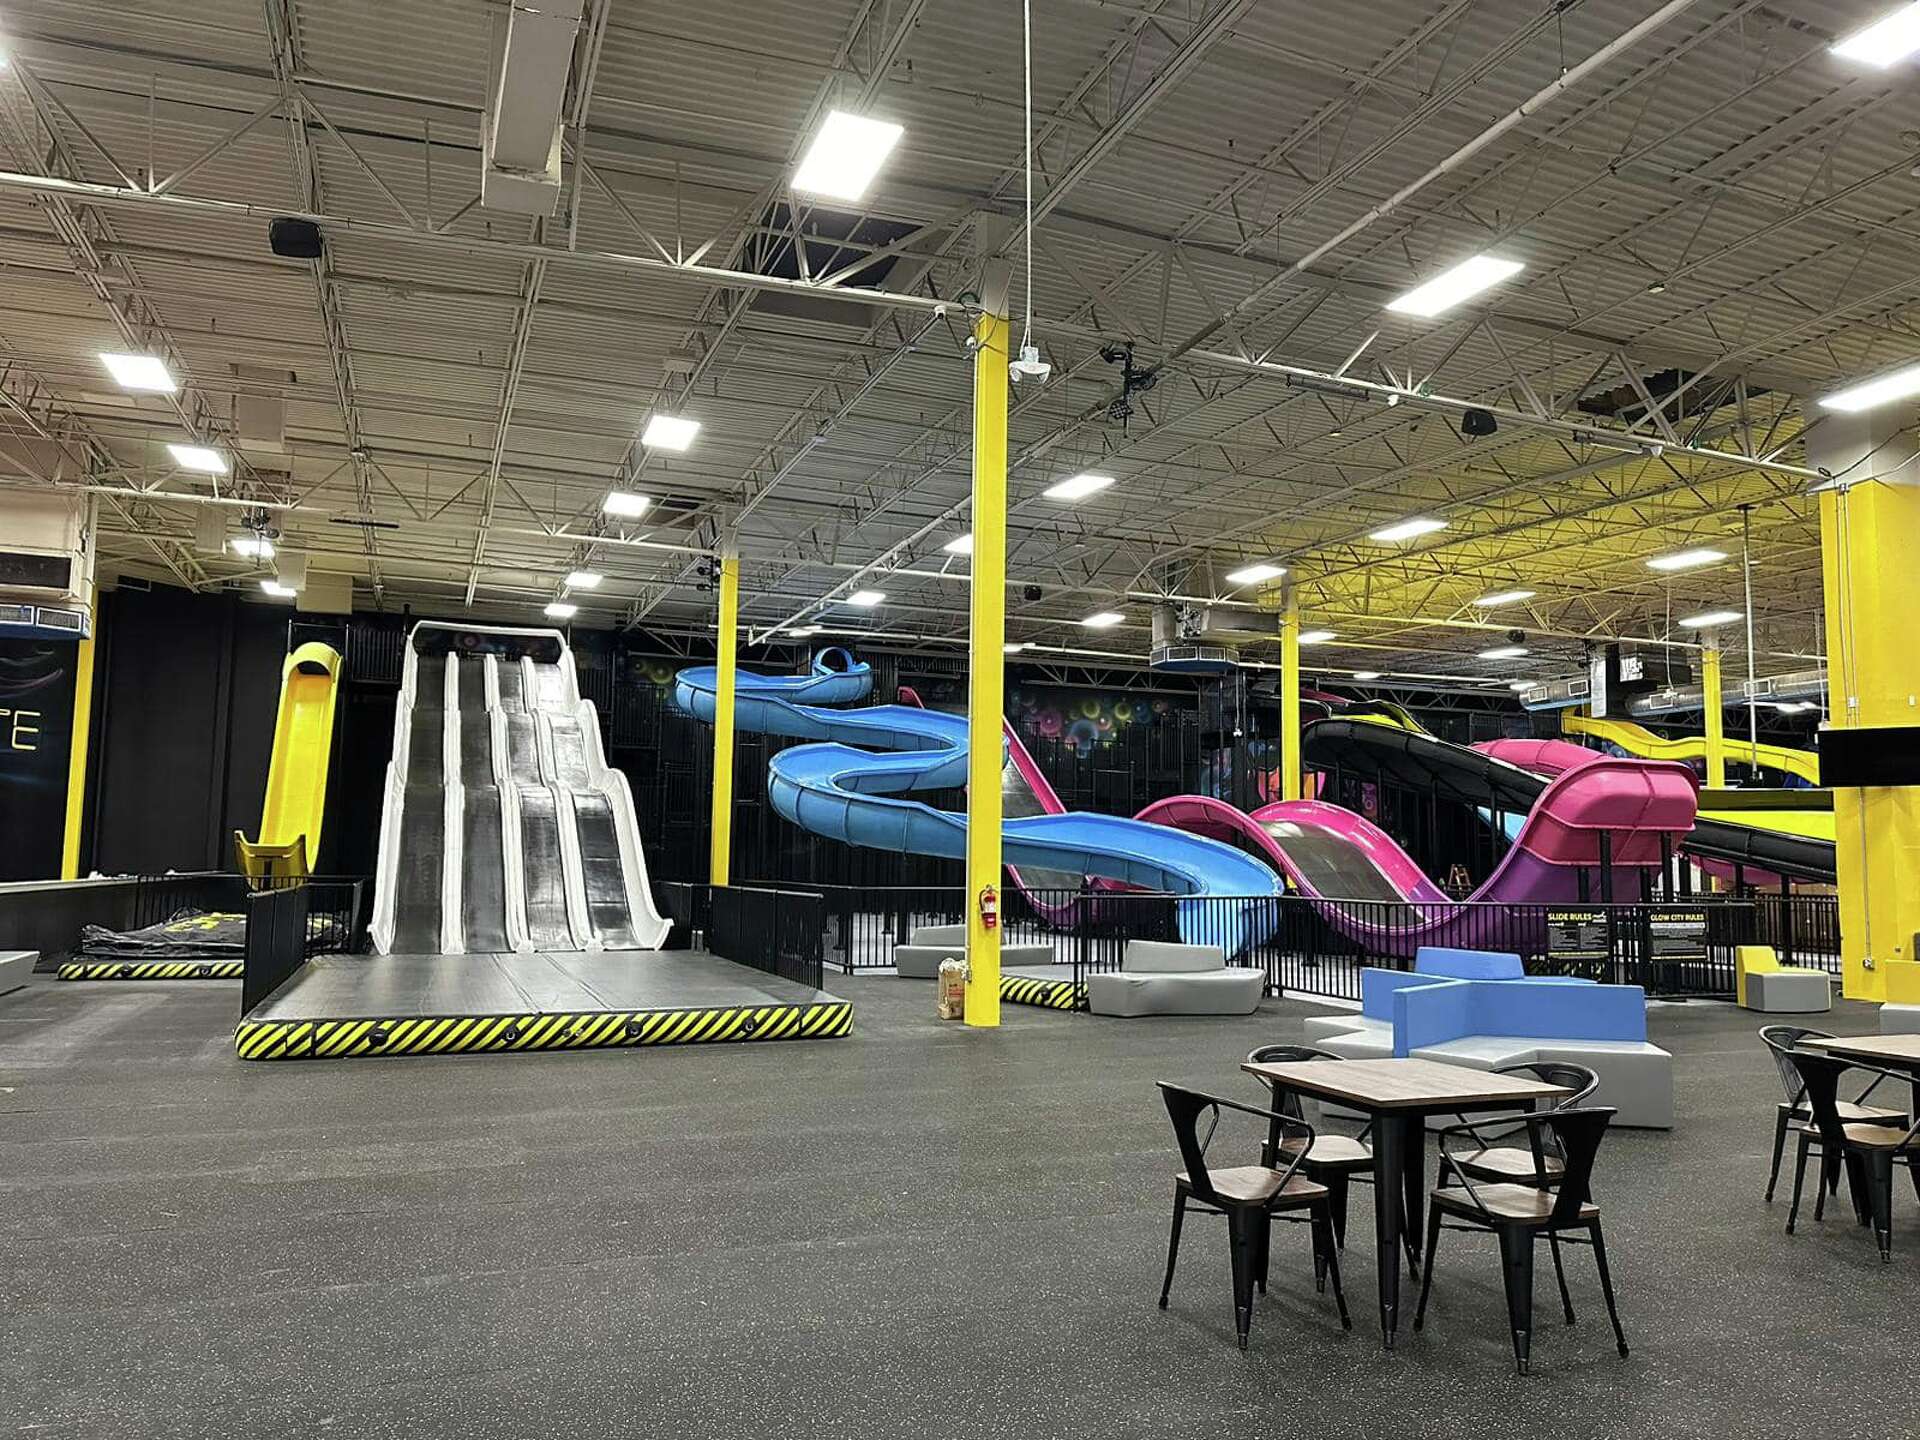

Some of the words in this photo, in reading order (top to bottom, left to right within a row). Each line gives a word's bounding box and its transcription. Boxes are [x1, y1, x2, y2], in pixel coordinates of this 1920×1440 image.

[1547, 912, 1569, 921] SLIDE
[1569, 912, 1592, 921] RULES
[1650, 913, 1670, 921] GLOW
